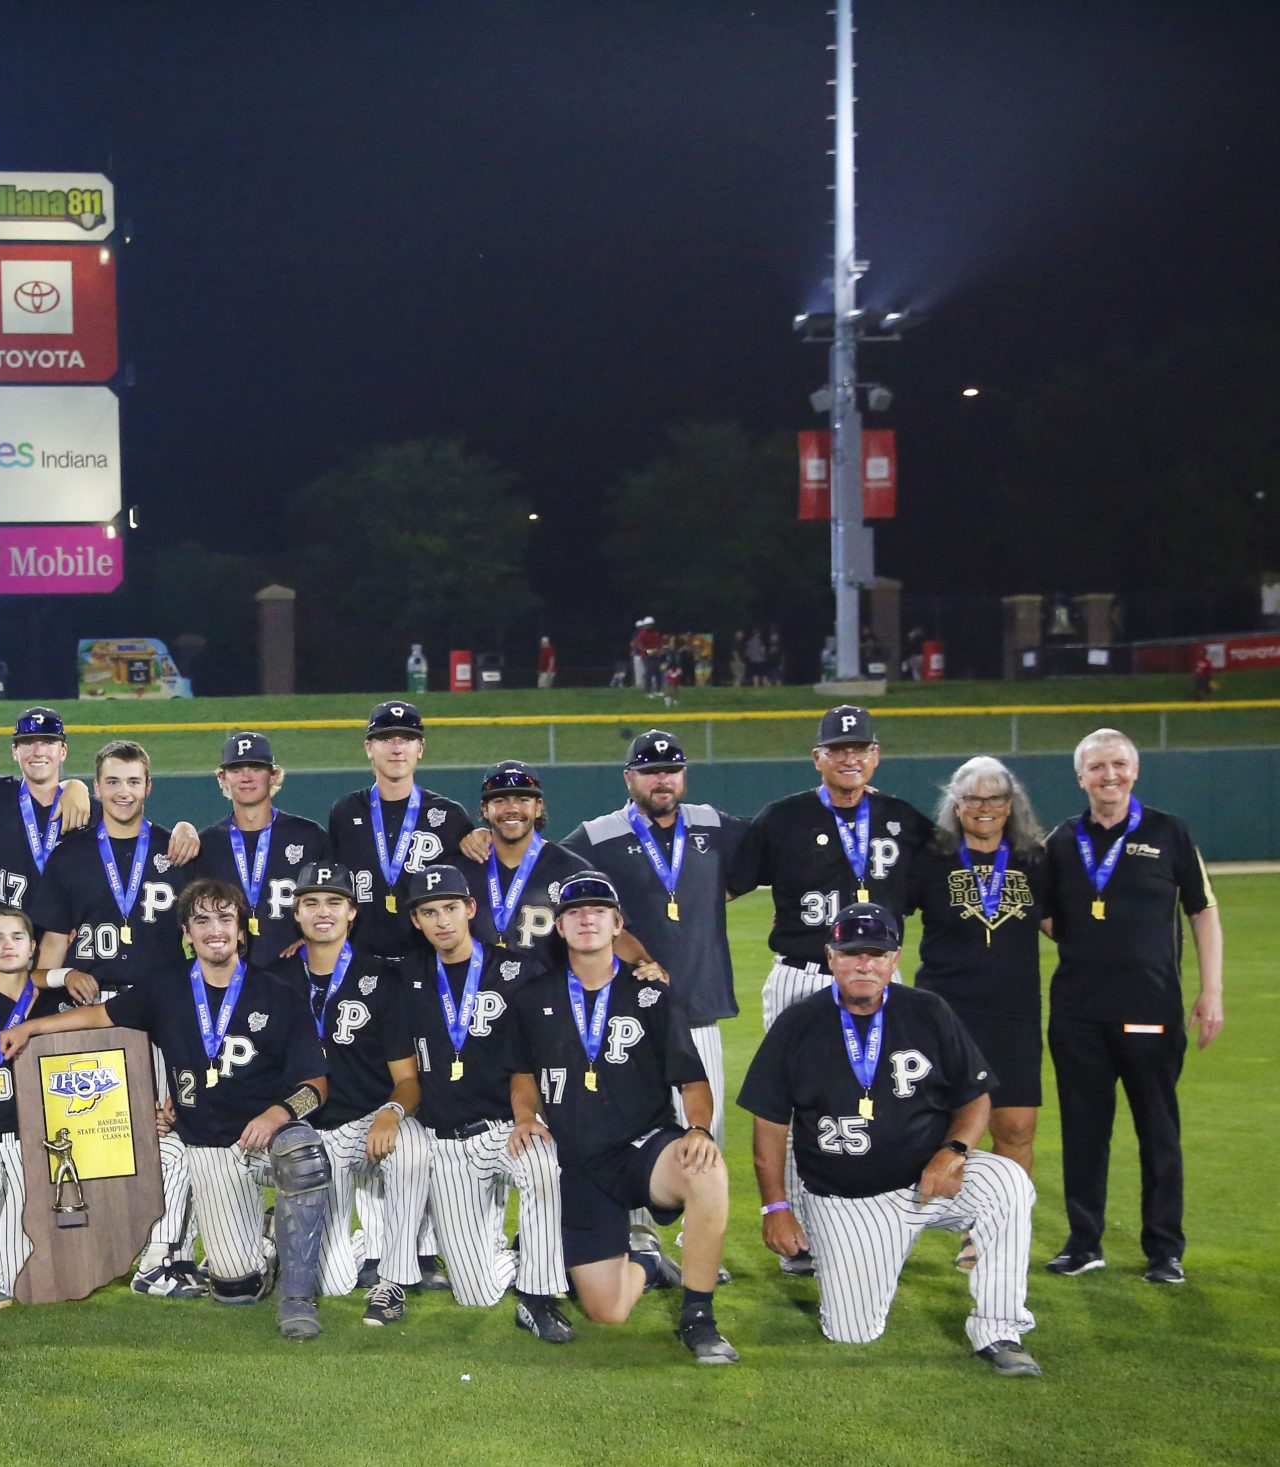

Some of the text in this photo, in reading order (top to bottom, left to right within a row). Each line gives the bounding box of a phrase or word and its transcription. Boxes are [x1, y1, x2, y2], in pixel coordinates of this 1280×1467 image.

[41, 451, 109, 468] Indiana
[841, 715, 857, 732] P
[237, 739, 252, 755] P
[404, 830, 444, 873] P
[870, 837, 900, 879] P
[317, 868, 332, 884] P
[350, 869, 373, 903] 2
[425, 872, 442, 890] P
[140, 881, 177, 923] P
[268, 878, 297, 919] P
[801, 890, 840, 926] 31
[76, 923, 119, 960] 20
[517, 905, 556, 948] P
[333, 1000, 371, 1045] P
[468, 990, 507, 1037] P
[218, 1034, 259, 1078] P
[604, 1016, 645, 1064] P
[49, 1068, 117, 1096] IHSAA
[888, 1049, 933, 1098] P
[77, 1125, 130, 1136] STATE CHAMPION
[97, 1118, 129, 1127] BASEBALL
[102, 1133, 122, 1141] CLASS
[818, 1115, 871, 1156] 25
